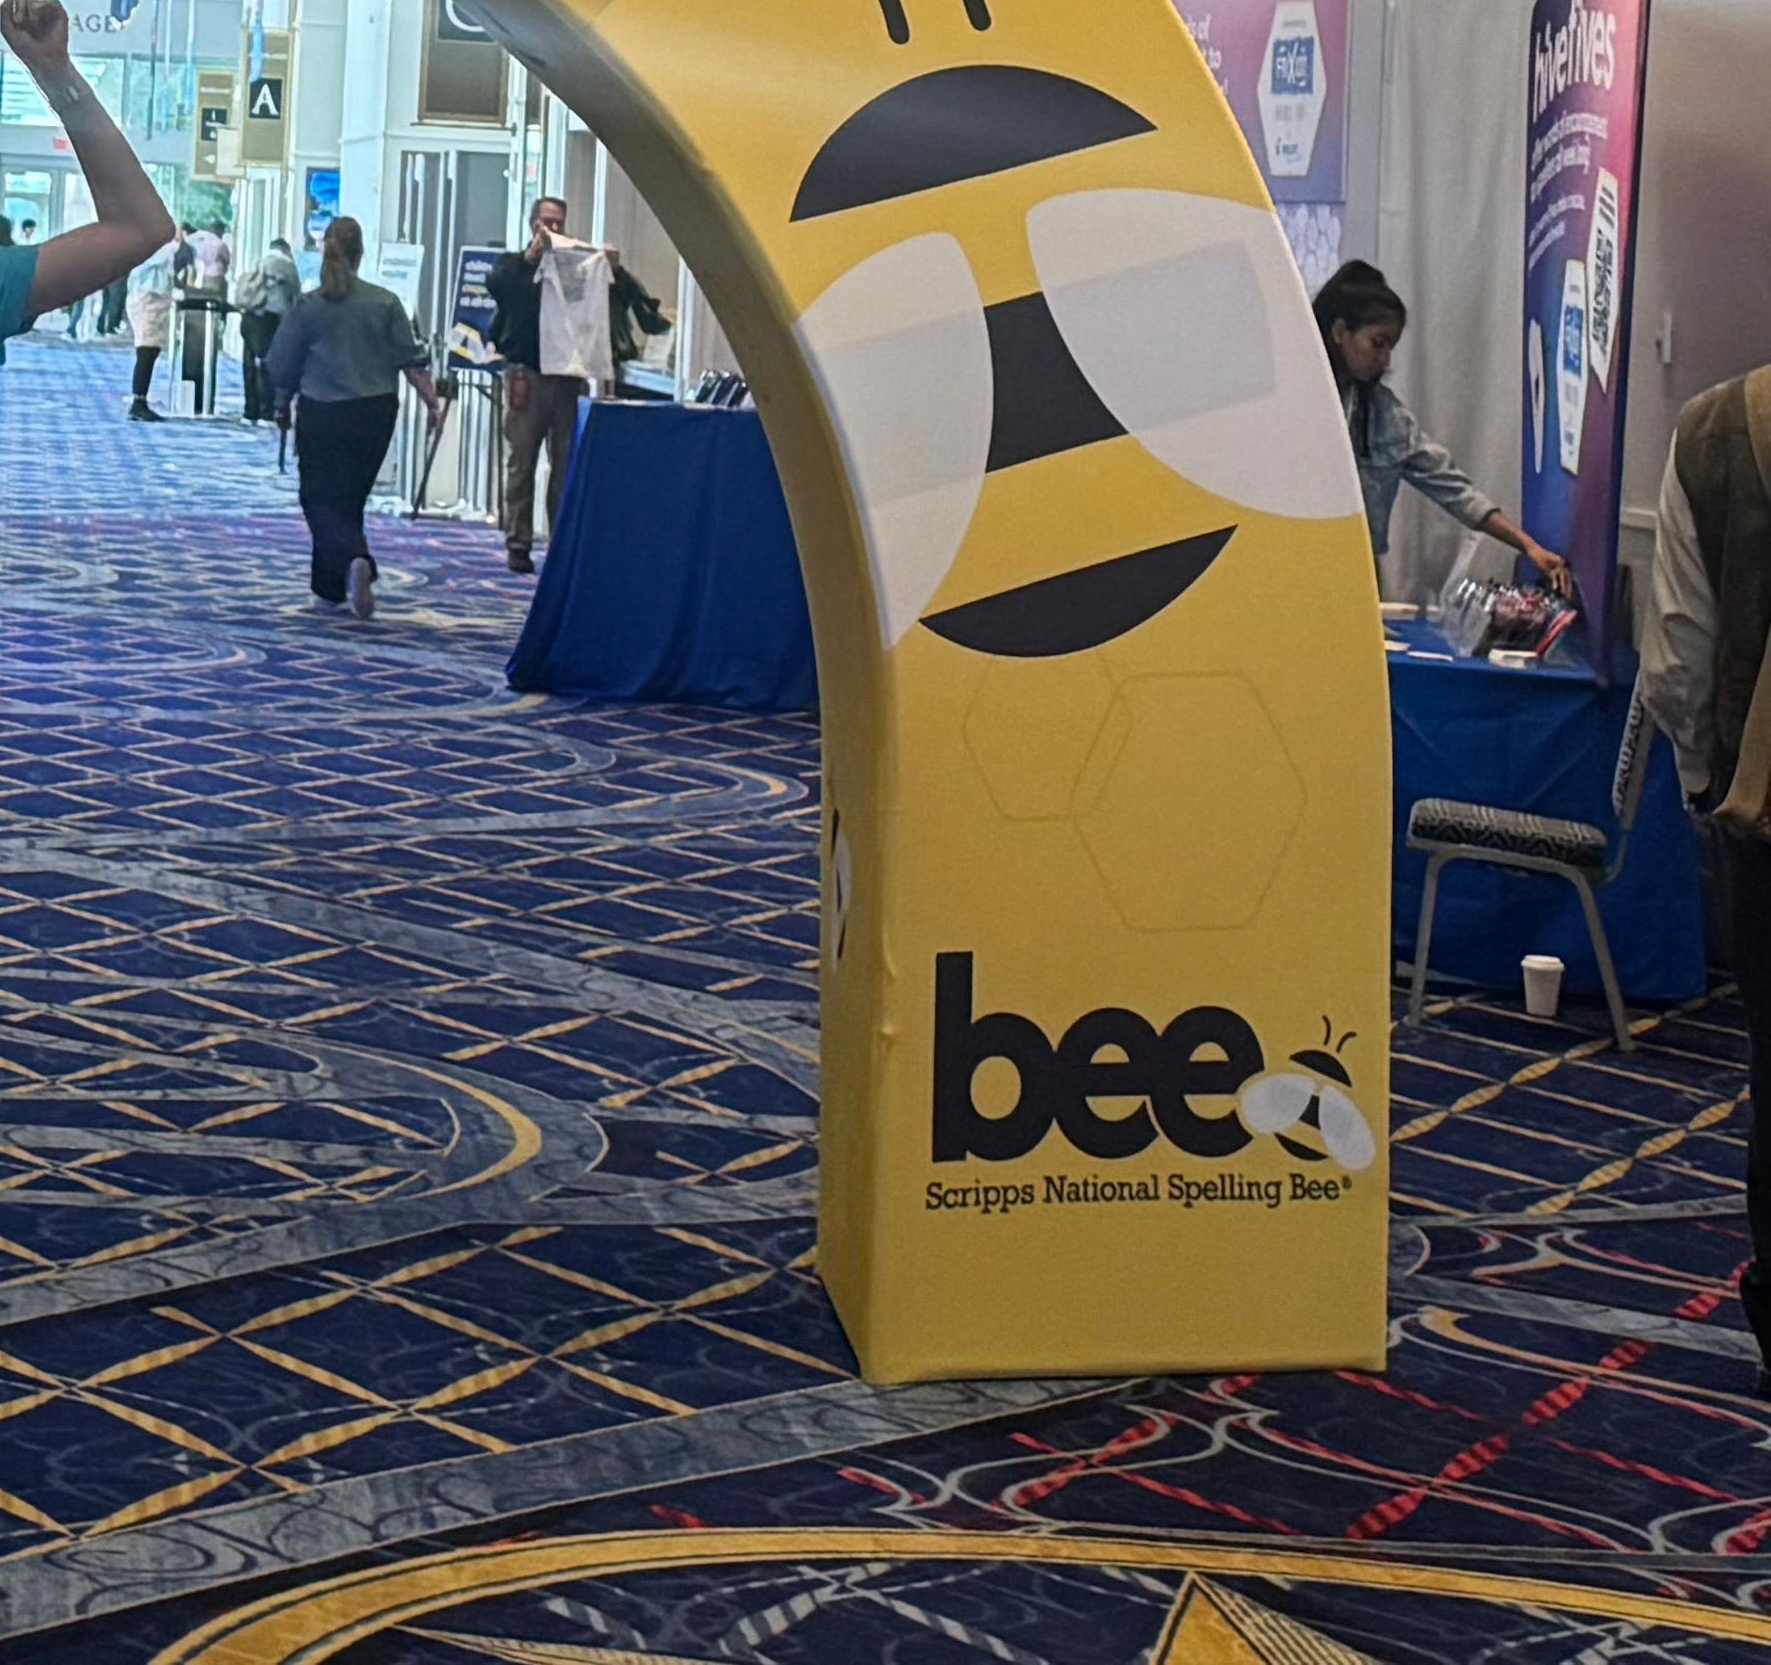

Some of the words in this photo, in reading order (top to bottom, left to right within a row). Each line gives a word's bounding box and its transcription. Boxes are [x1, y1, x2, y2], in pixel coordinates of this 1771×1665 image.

[69, 14, 117, 34] AGE
[251, 83, 279, 115] A
[932, 951, 1265, 1163] bee
[926, 1179, 1035, 1215] Scripps
[1043, 1175, 1160, 1205] National
[1168, 1174, 1282, 1208] Spelling
